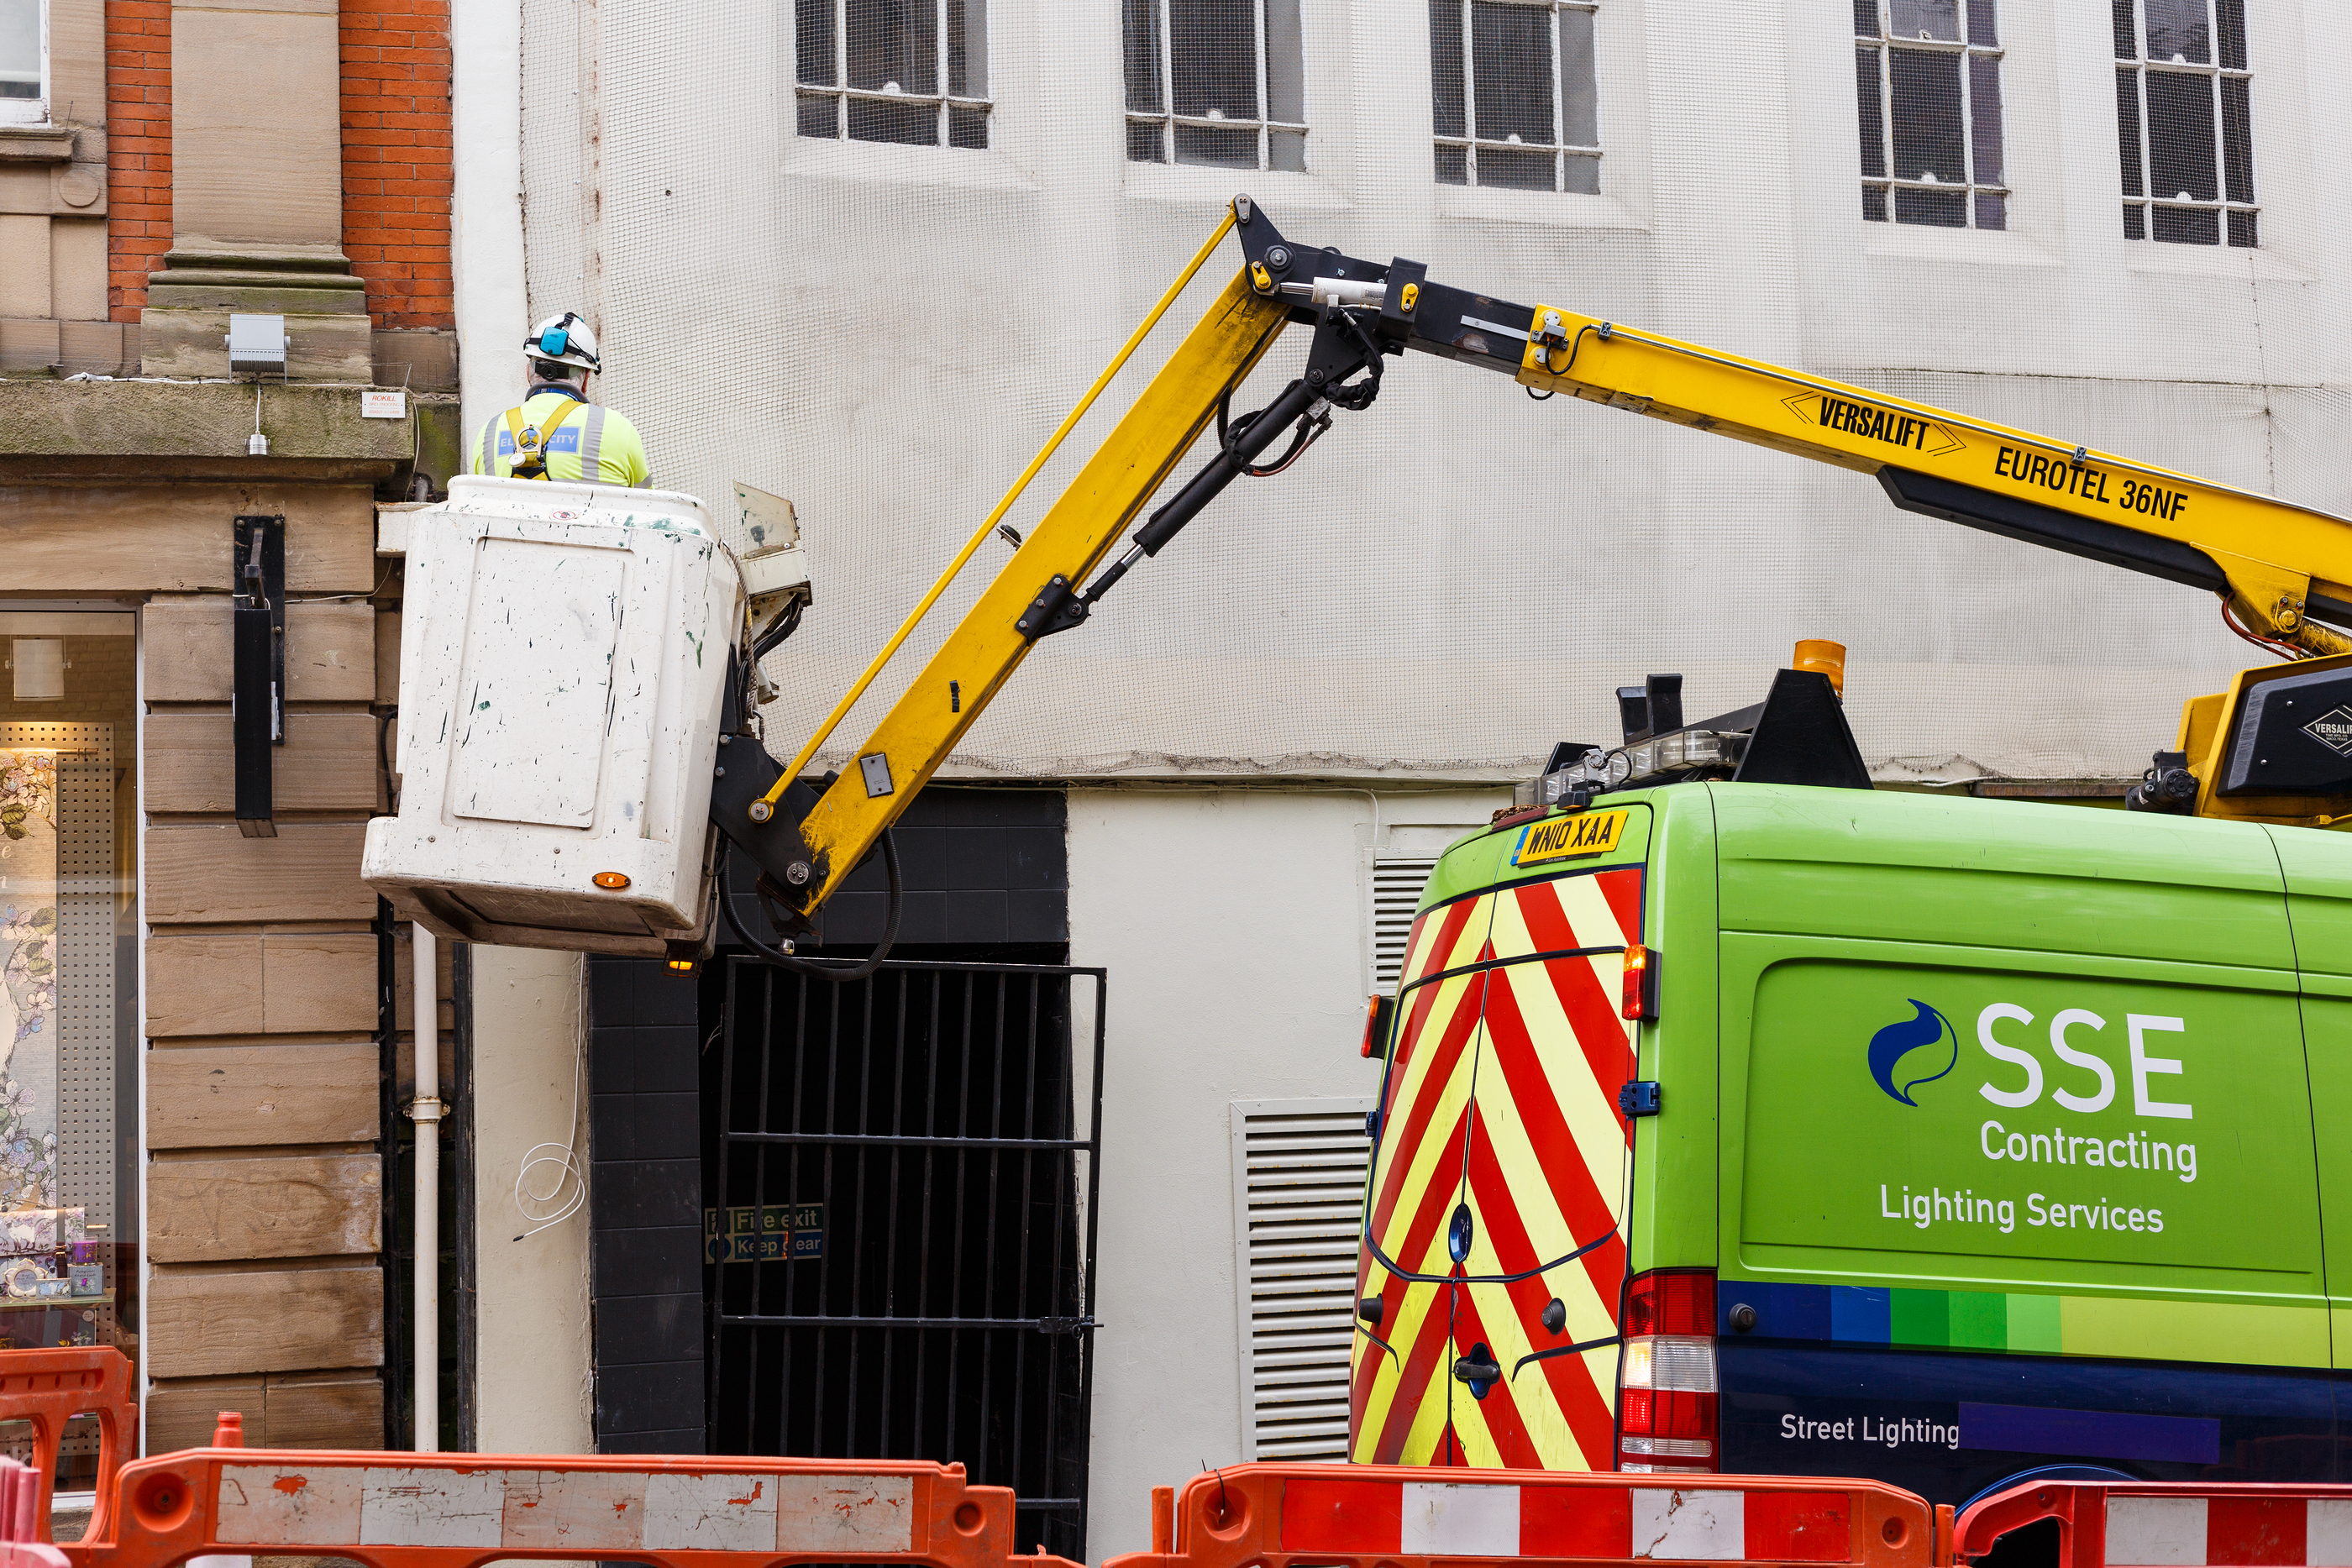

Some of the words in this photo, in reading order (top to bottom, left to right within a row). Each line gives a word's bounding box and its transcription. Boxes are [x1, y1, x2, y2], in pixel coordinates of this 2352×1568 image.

[500, 434, 576, 448] ELCITY
[1819, 396, 1929, 450] VERSALIFT
[1994, 446, 2110, 504] EUROTEL
[2119, 480, 2188, 522] 36NF
[1527, 821, 1572, 855] WN10
[1570, 815, 1614, 847] XAA
[1977, 1002, 2193, 1120] SSE
[1981, 1120, 2197, 1183] Contracting
[737, 1212, 775, 1230] Fie
[1881, 1184, 2015, 1234] Lighting
[2026, 1193, 2164, 1233] Services
[783, 1239, 821, 1252] cear
[1780, 1413, 1854, 1440] Street
[1863, 1416, 1959, 1450] Lighting
